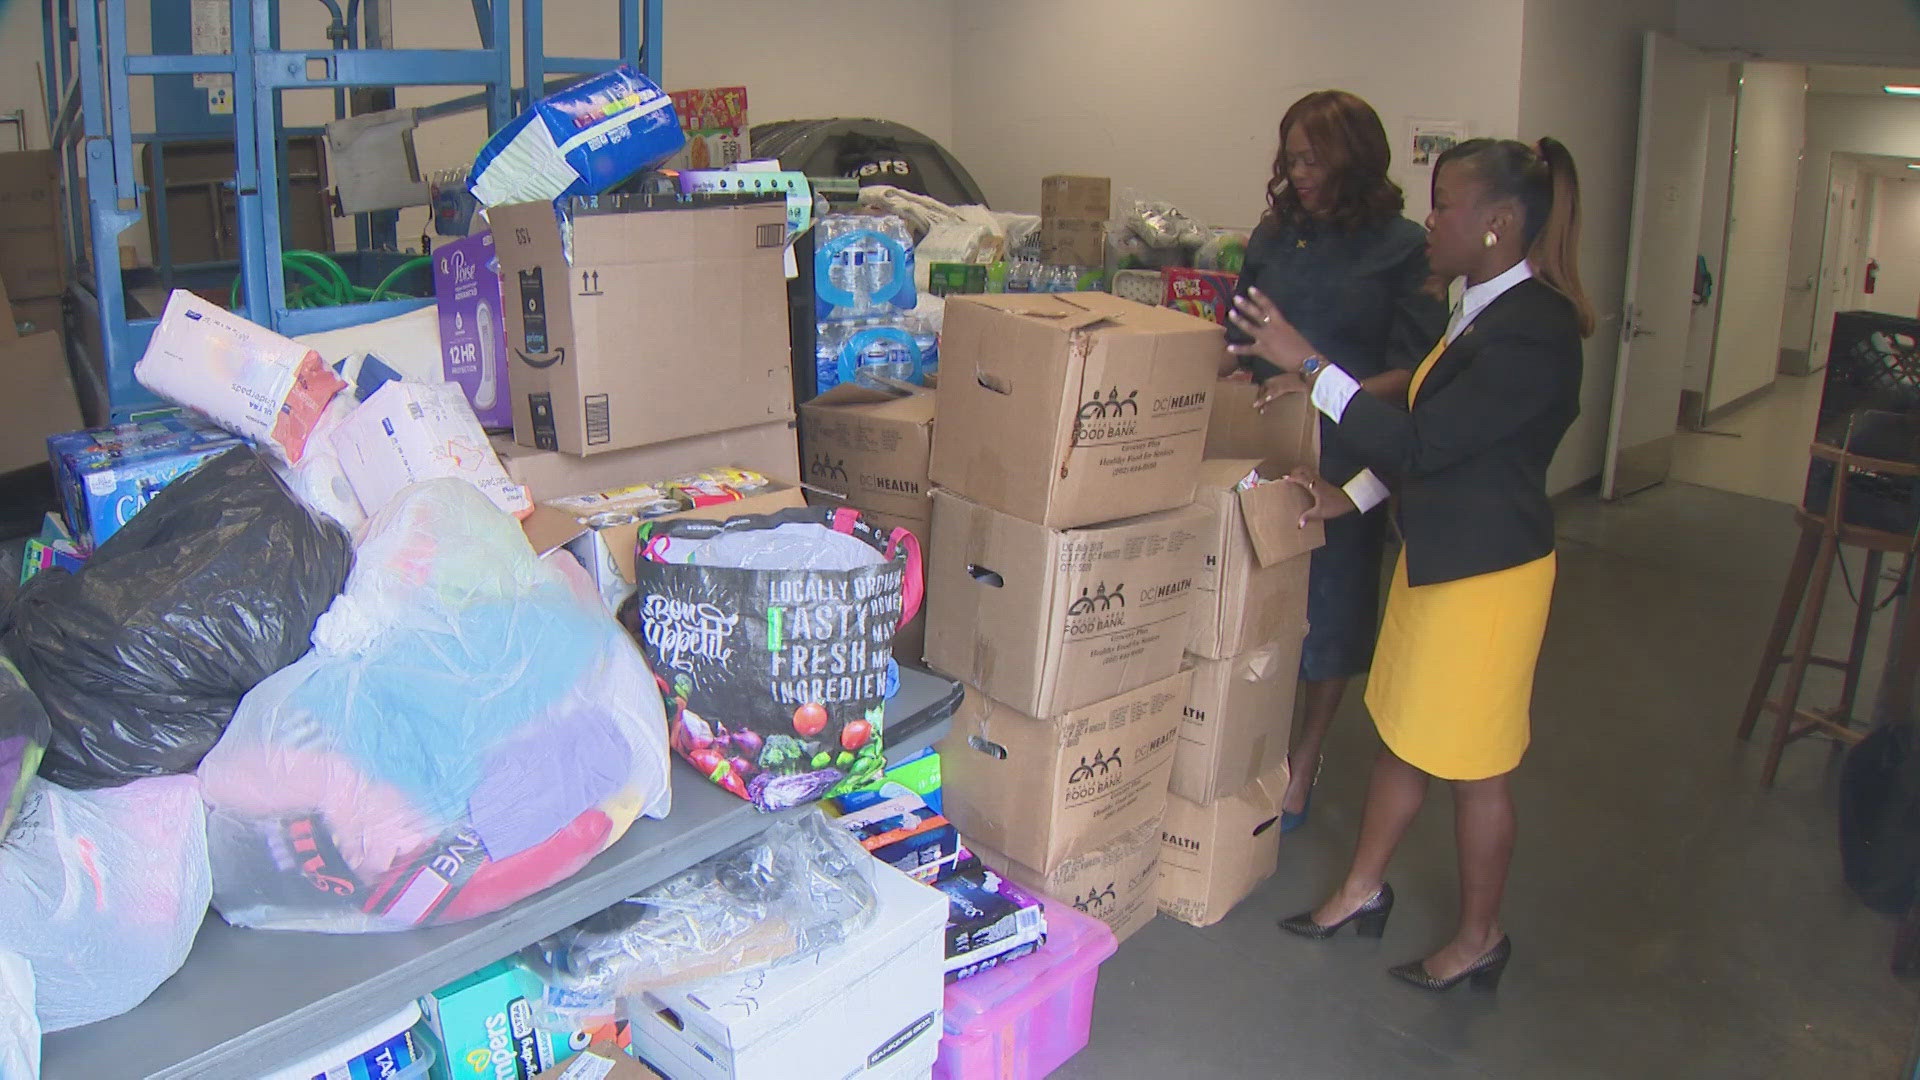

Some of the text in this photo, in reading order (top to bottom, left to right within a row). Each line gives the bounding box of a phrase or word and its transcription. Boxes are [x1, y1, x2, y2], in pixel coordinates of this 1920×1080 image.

[451, 250, 477, 284] Poise
[526, 333, 545, 345] prime
[449, 346, 476, 365] 12 HR
[769, 579, 849, 604] LOCALLY
[768, 604, 869, 642] TASTY
[771, 640, 867, 677] FRESH
